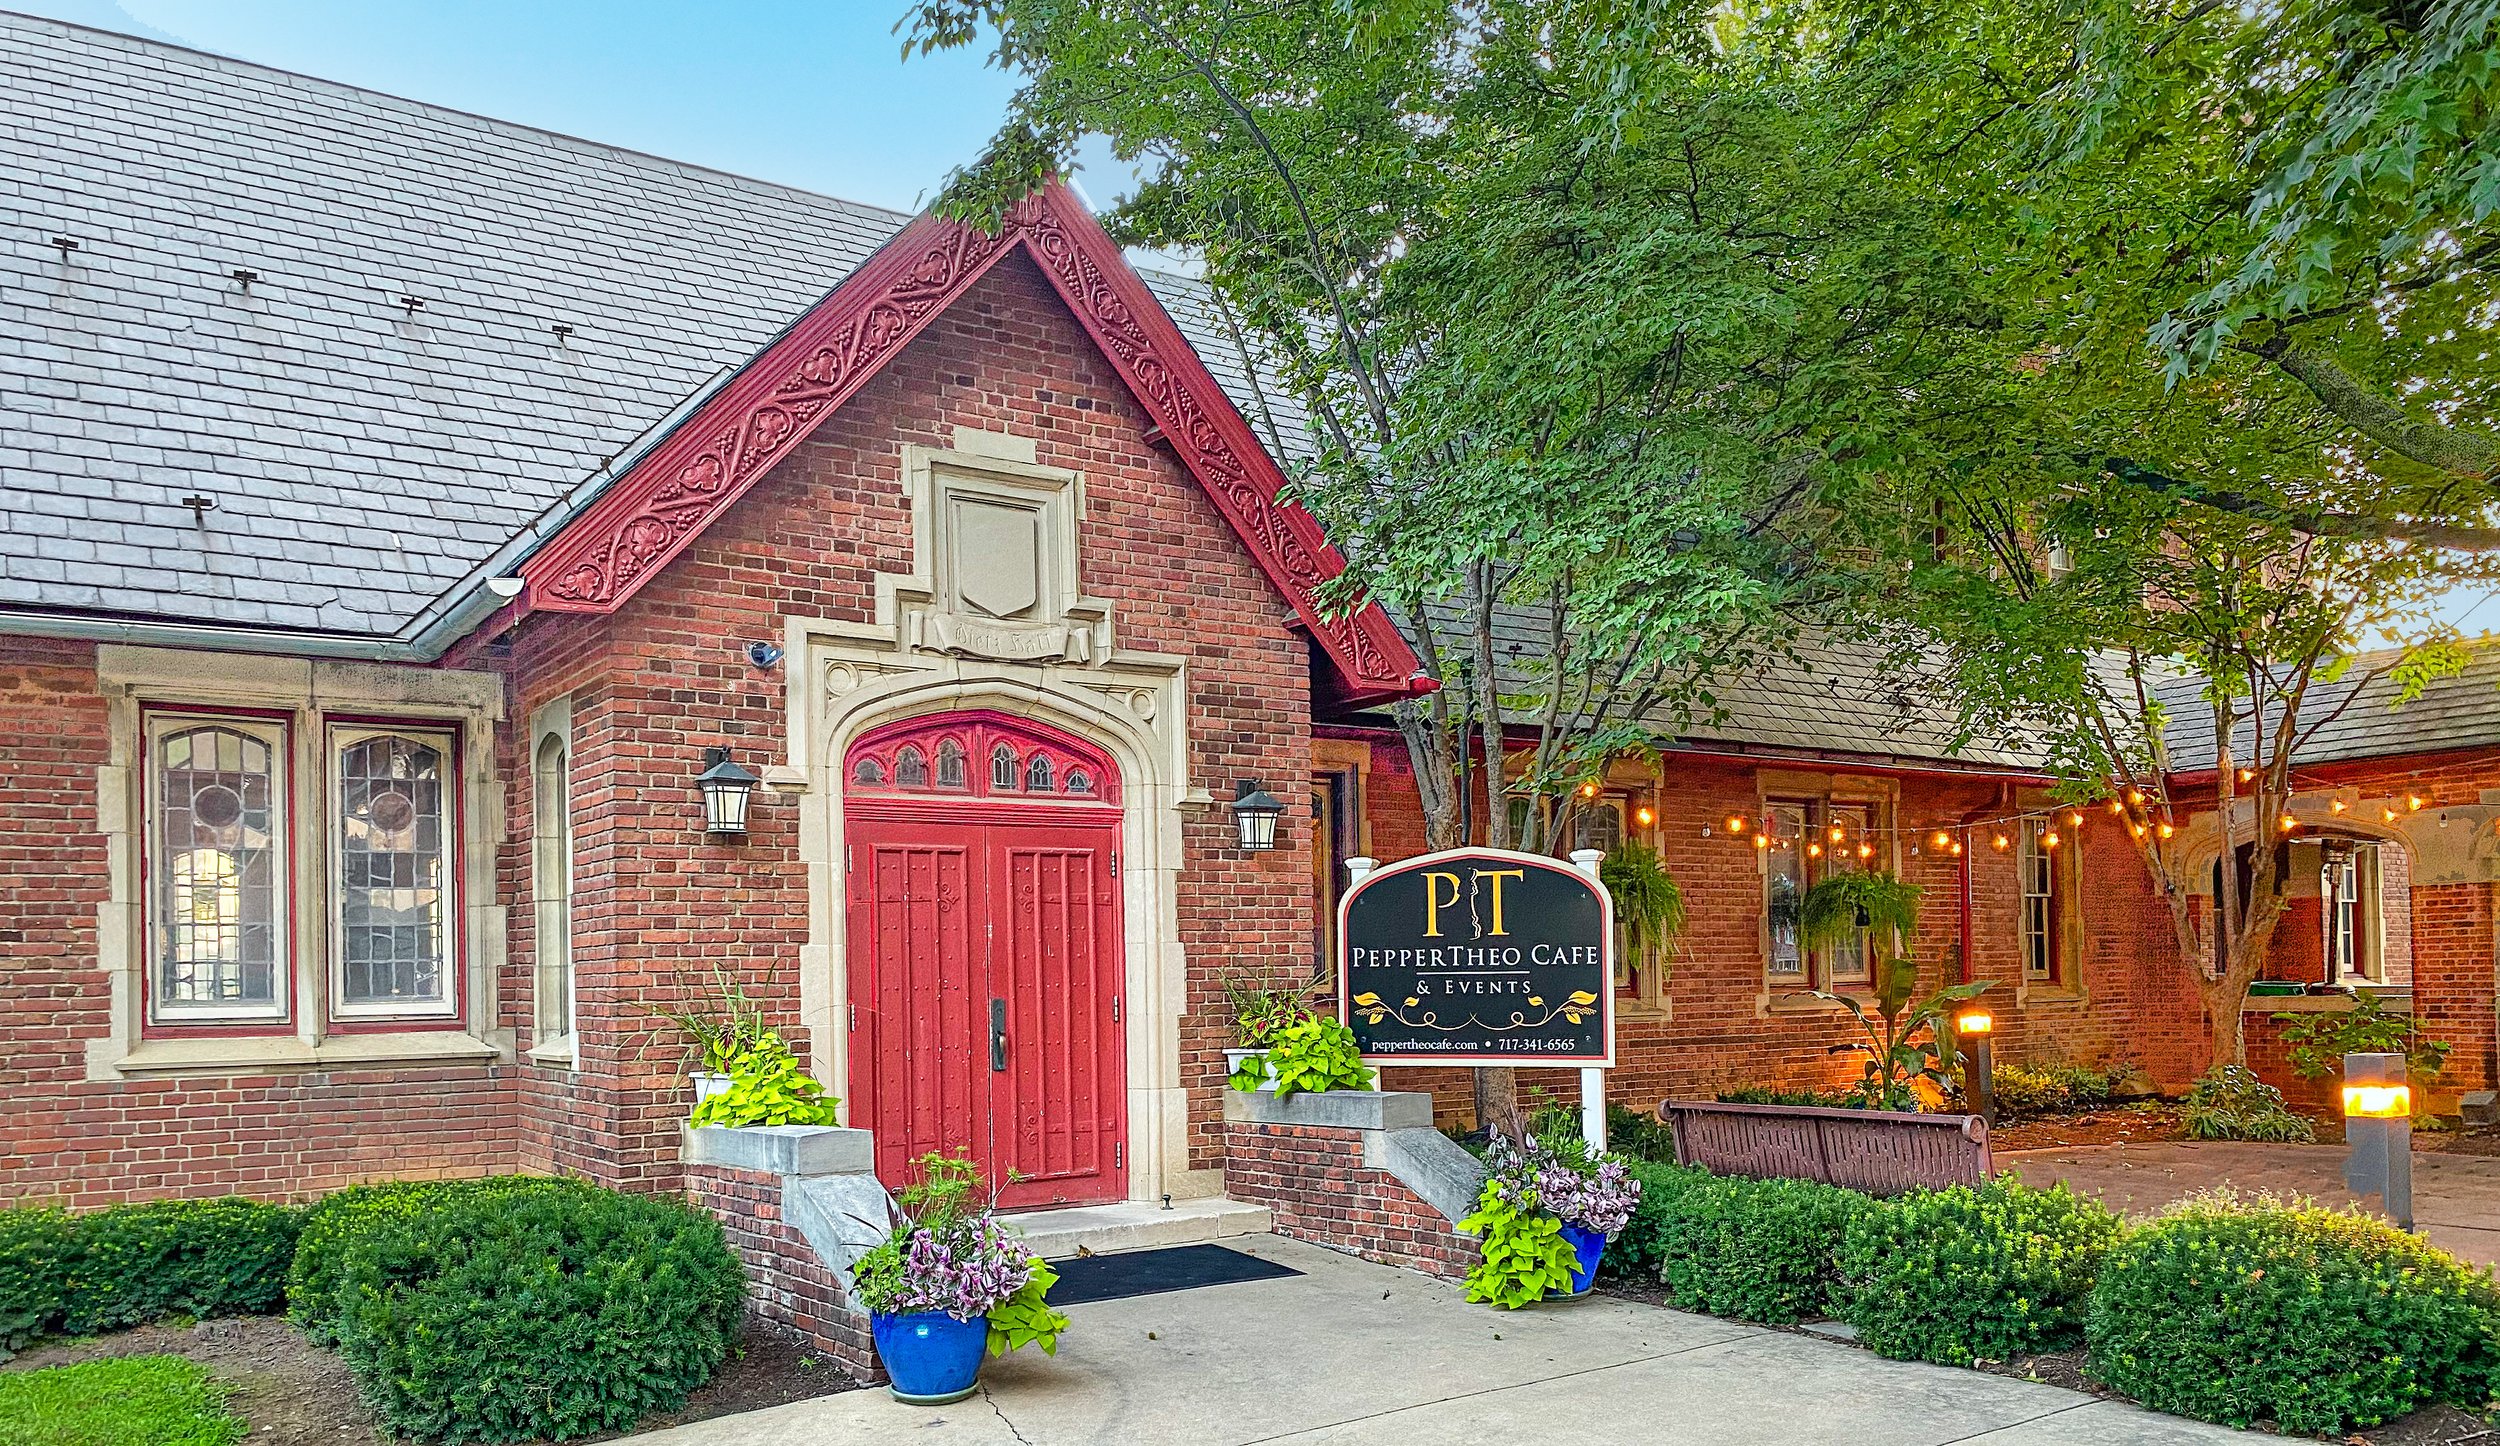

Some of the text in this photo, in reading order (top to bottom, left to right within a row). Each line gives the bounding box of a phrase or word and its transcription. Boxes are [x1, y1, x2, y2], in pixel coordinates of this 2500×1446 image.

[1416, 980, 1532, 995] & EVENTS
[1371, 1037, 1575, 1052] peppertheocafe.com 717-341-6565
